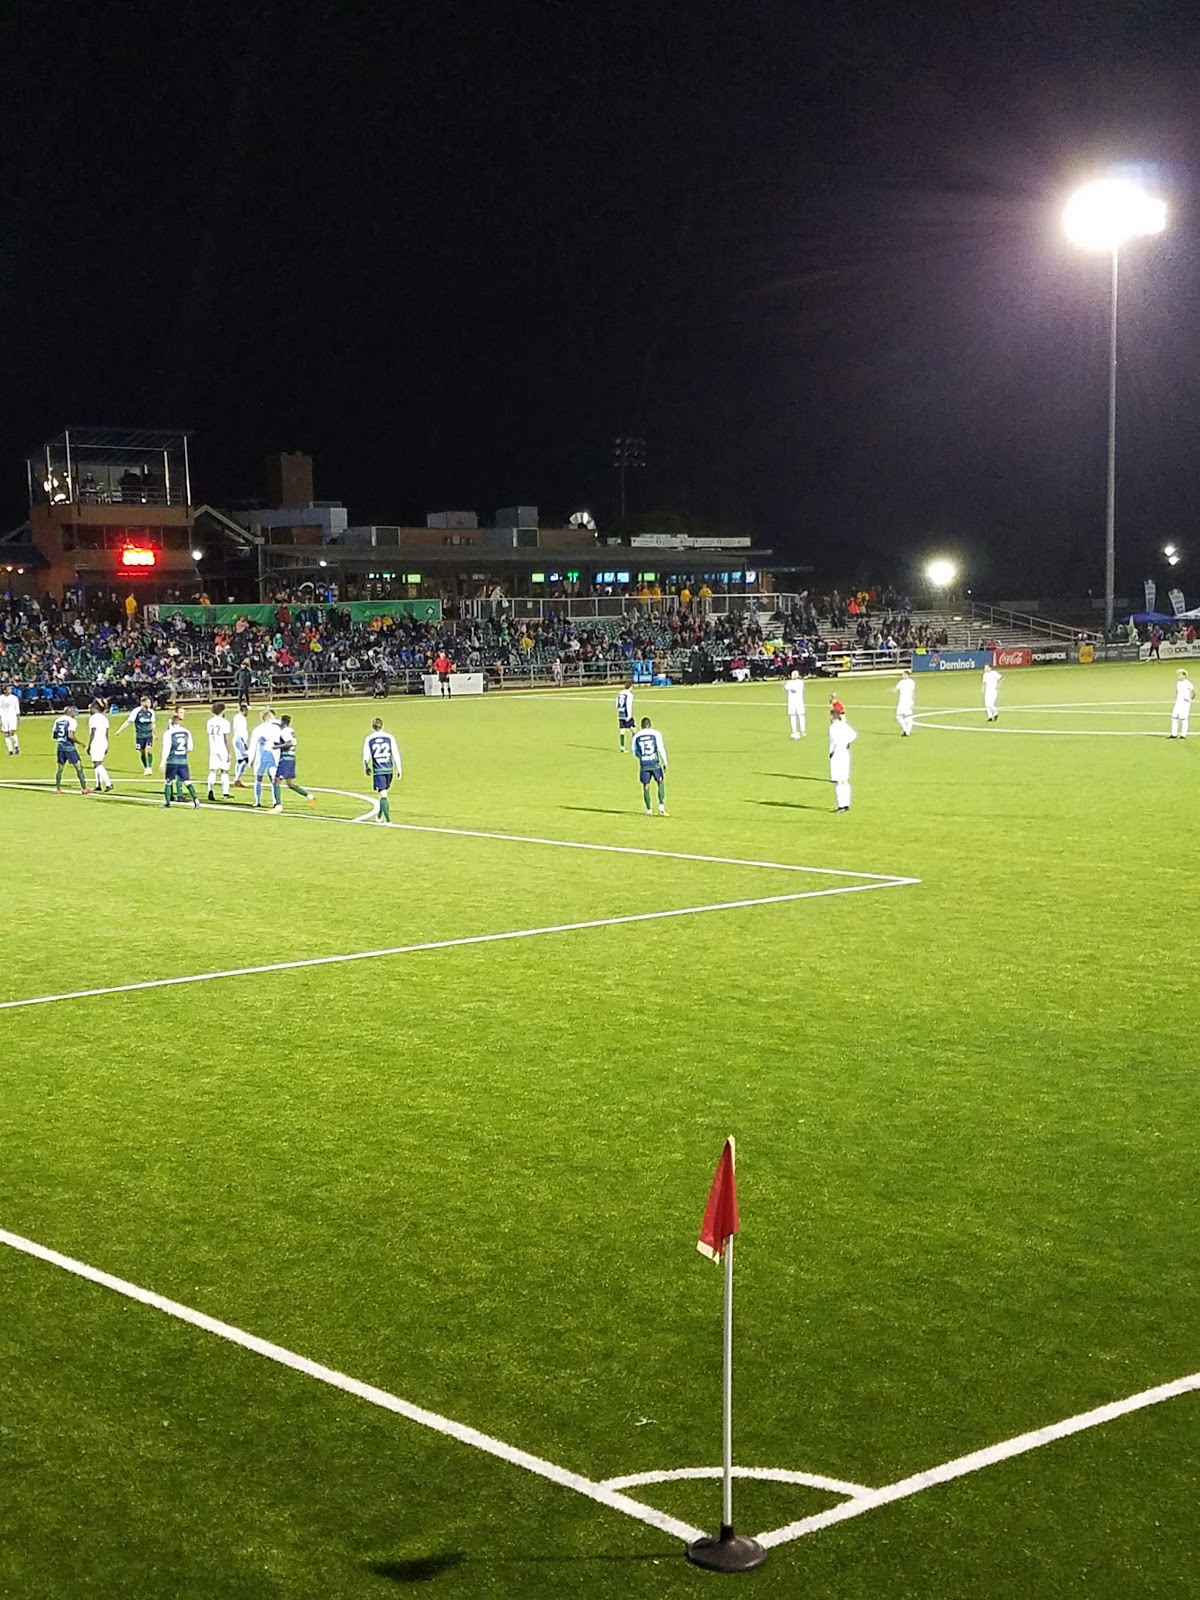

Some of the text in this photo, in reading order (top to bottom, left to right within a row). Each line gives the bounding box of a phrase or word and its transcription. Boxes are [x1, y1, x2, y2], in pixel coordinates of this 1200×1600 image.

[940, 658, 976, 670] Domino's
[57, 725, 66, 737] 3
[176, 738, 187, 751] 2
[372, 744, 391, 758] 22
[639, 741, 654, 755] 13
